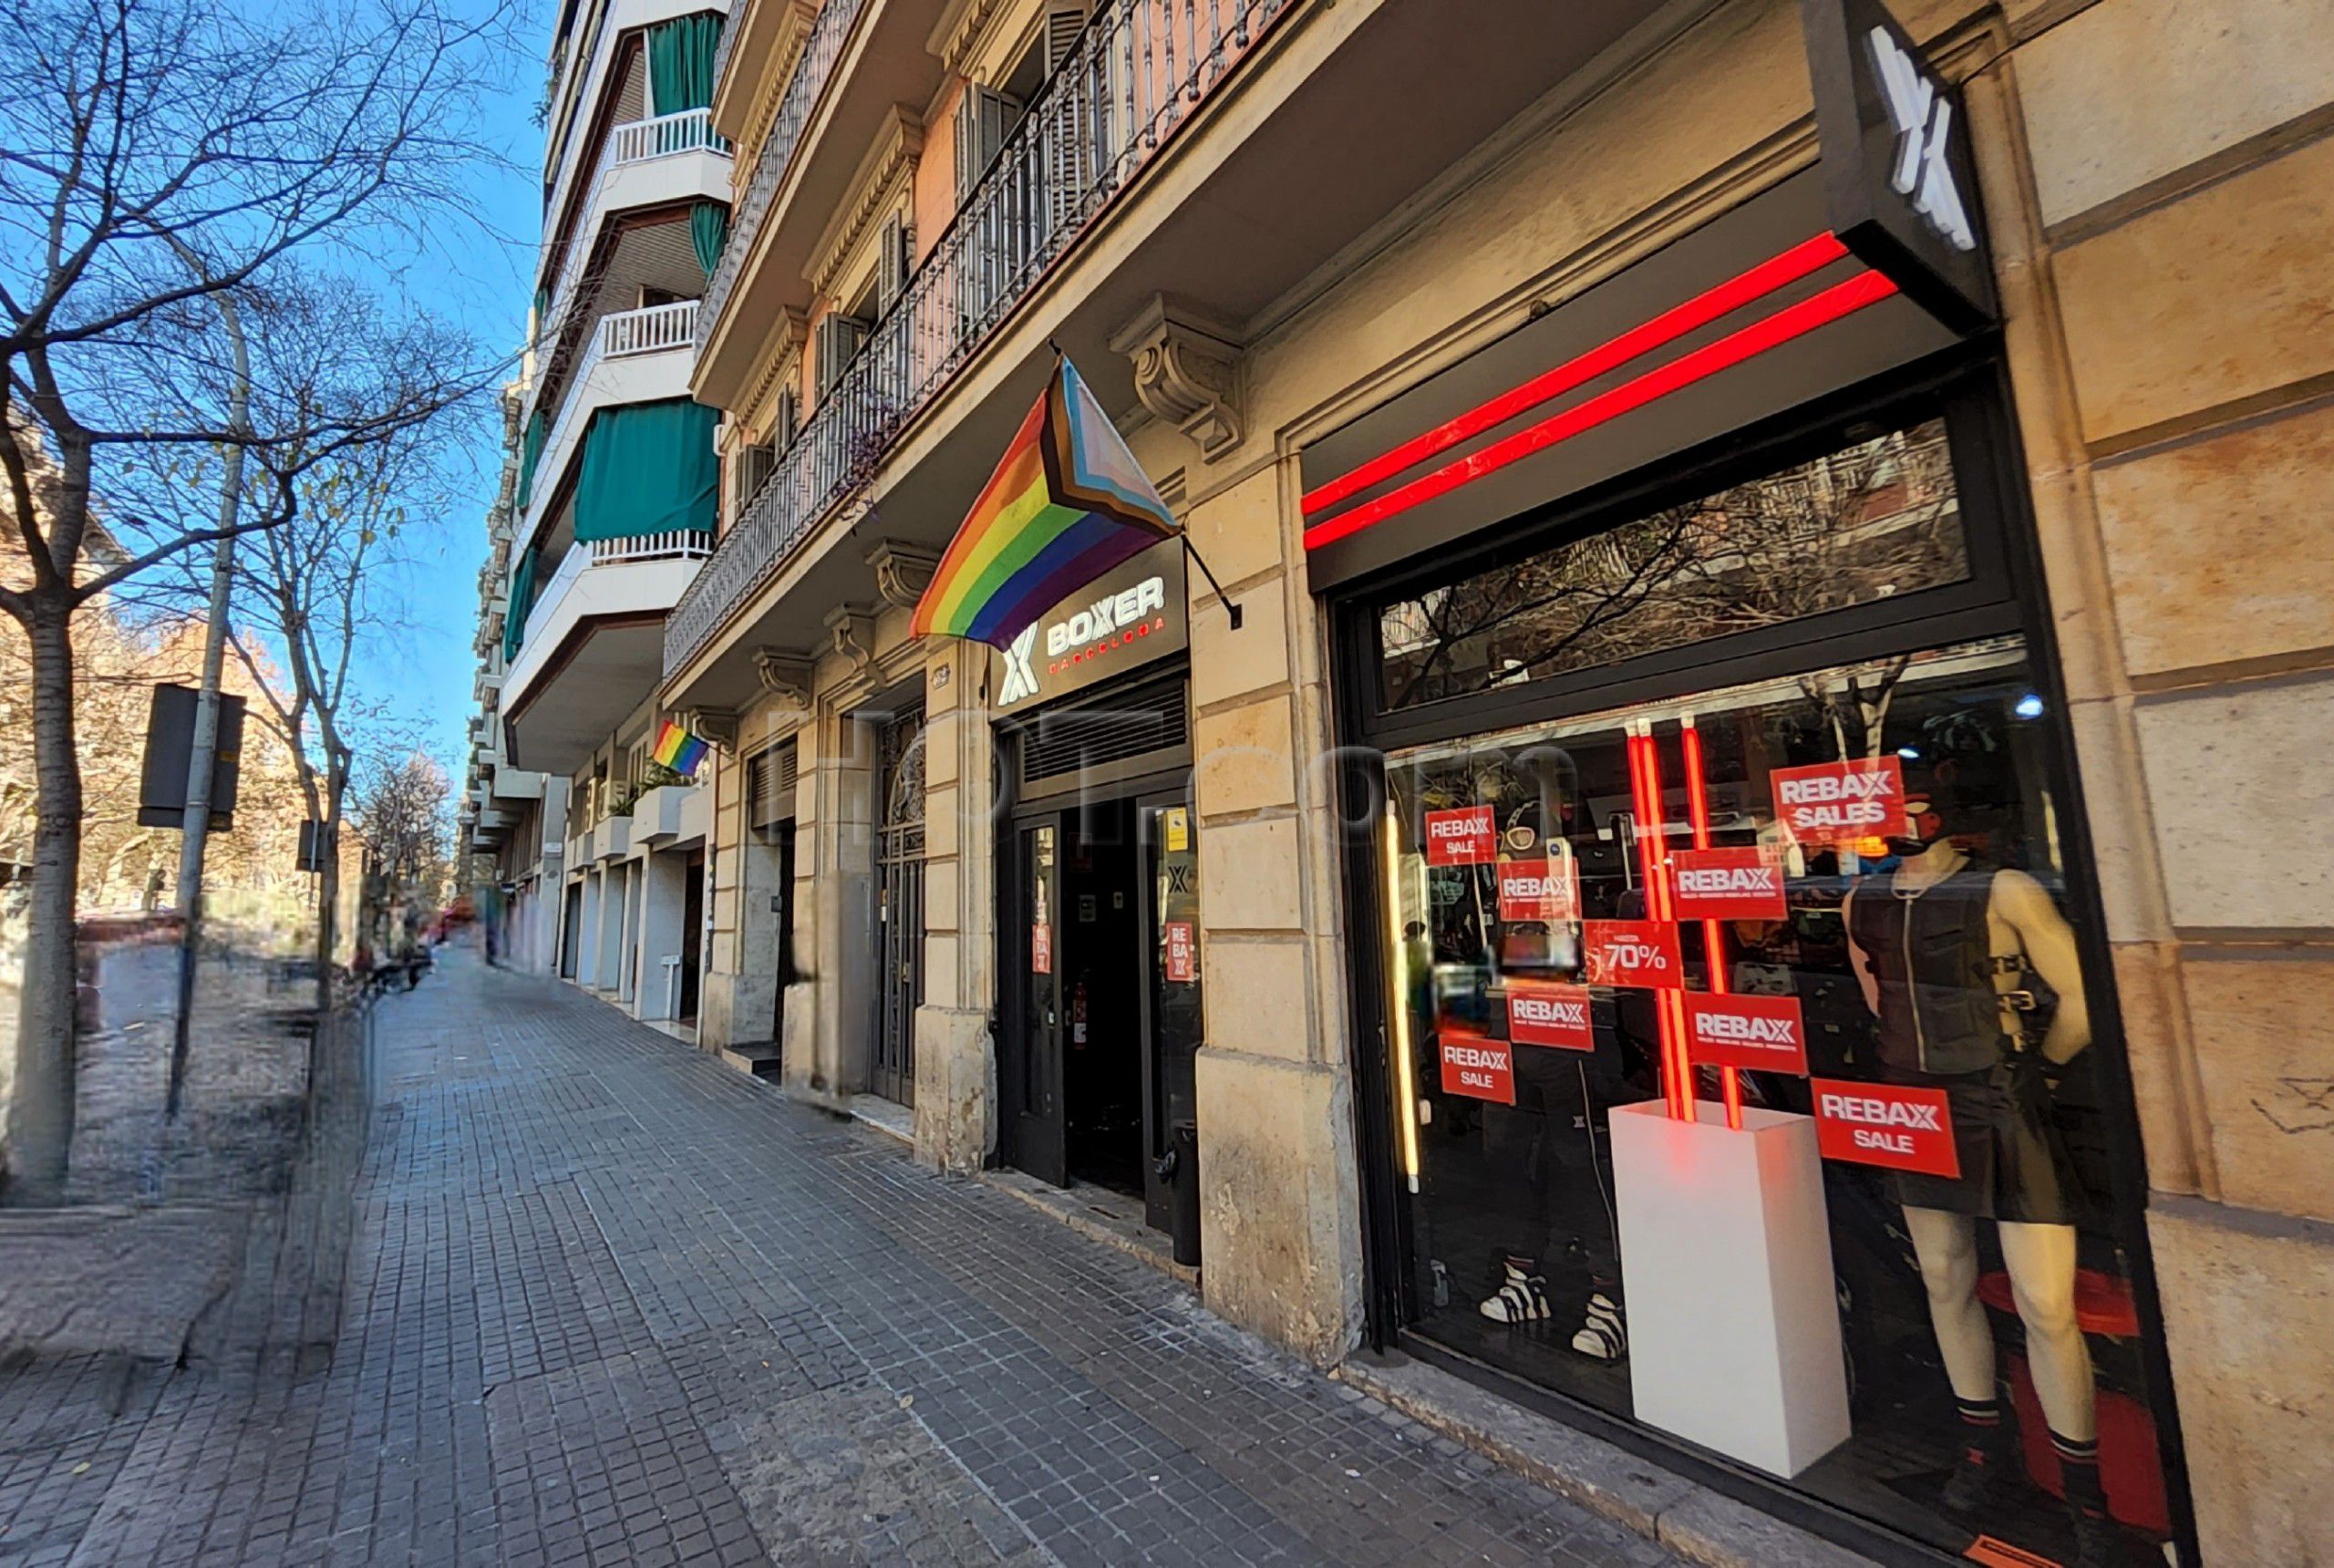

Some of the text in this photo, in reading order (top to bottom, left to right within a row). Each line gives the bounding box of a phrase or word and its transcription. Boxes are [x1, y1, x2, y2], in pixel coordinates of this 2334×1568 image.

[1047, 576, 1165, 656] BOXER
[1779, 770, 1895, 804] REBAX
[1793, 800, 1885, 828] SALES
[1430, 817, 1491, 839] REBAX
[1446, 840, 1476, 854] SALE
[1503, 876, 1575, 898] REBAX
[1677, 867, 1777, 892] REBAX
[1603, 944, 1667, 970] 70%
[1513, 998, 1585, 1024] REBAX
[1695, 1012, 1796, 1044] REBAX
[1443, 1045, 1509, 1071] REBAX
[1461, 1070, 1494, 1089] SALE
[1822, 1094, 1943, 1132] REBAX
[1854, 1129, 1916, 1155] SALE
